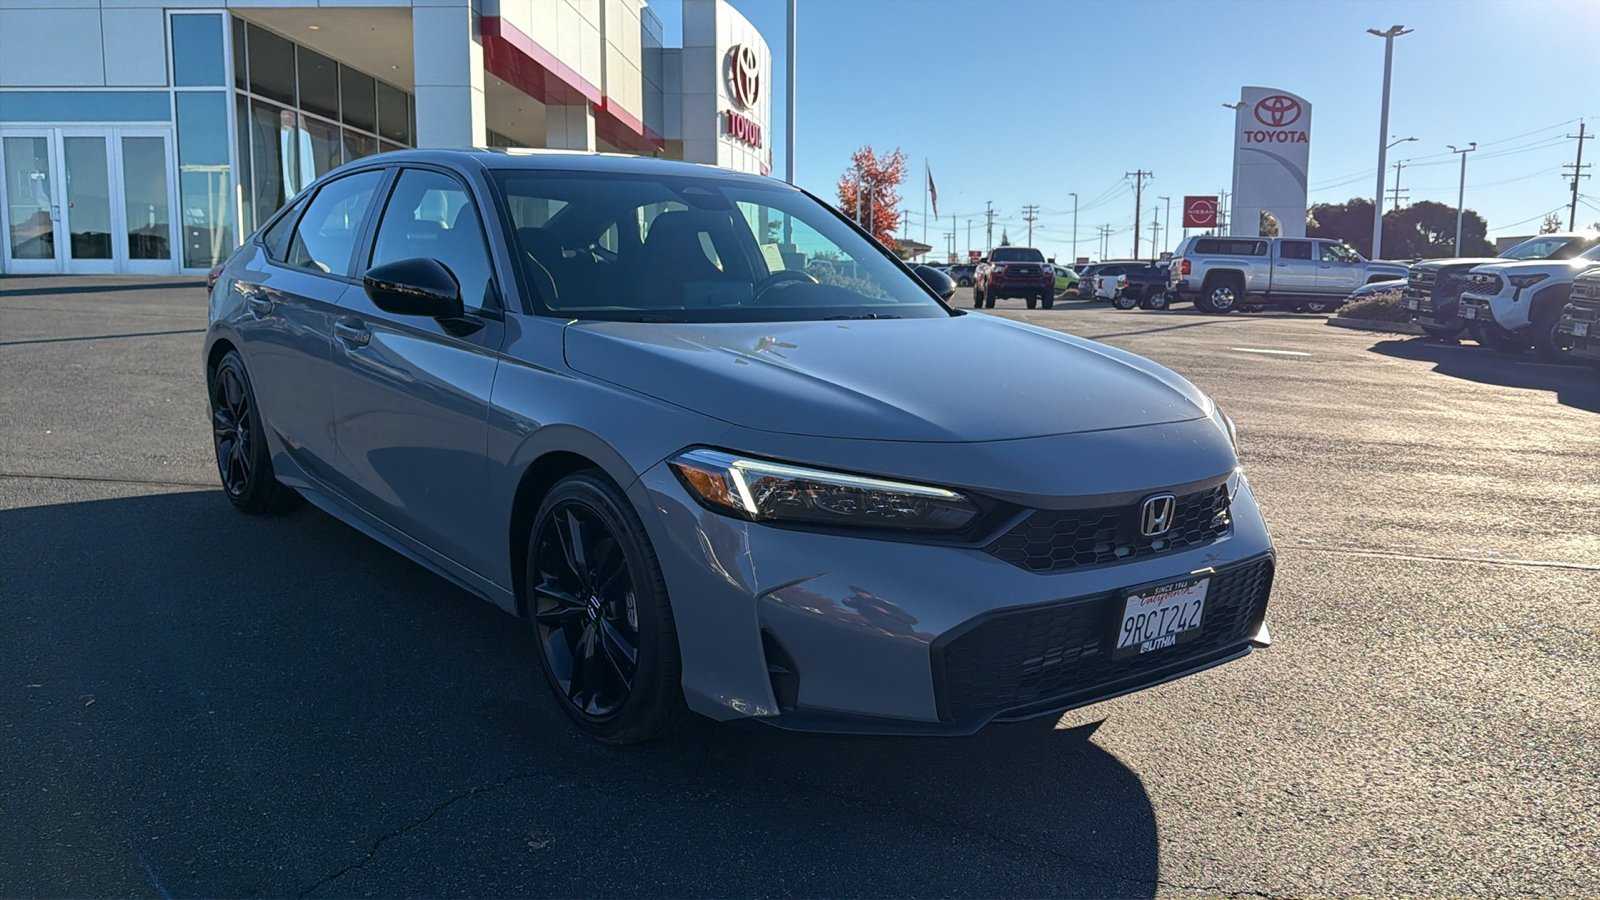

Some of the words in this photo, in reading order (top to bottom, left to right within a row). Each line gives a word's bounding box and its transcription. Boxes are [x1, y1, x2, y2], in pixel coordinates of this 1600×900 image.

[727, 109, 762, 149] TOYOTA
[1244, 131, 1308, 143] TOYOTA
[1140, 589, 1194, 607] California
[1154, 583, 1174, 595] SINCE
[1121, 600, 1202, 648] 9RCT242
[1147, 634, 1176, 652] LITHIA
